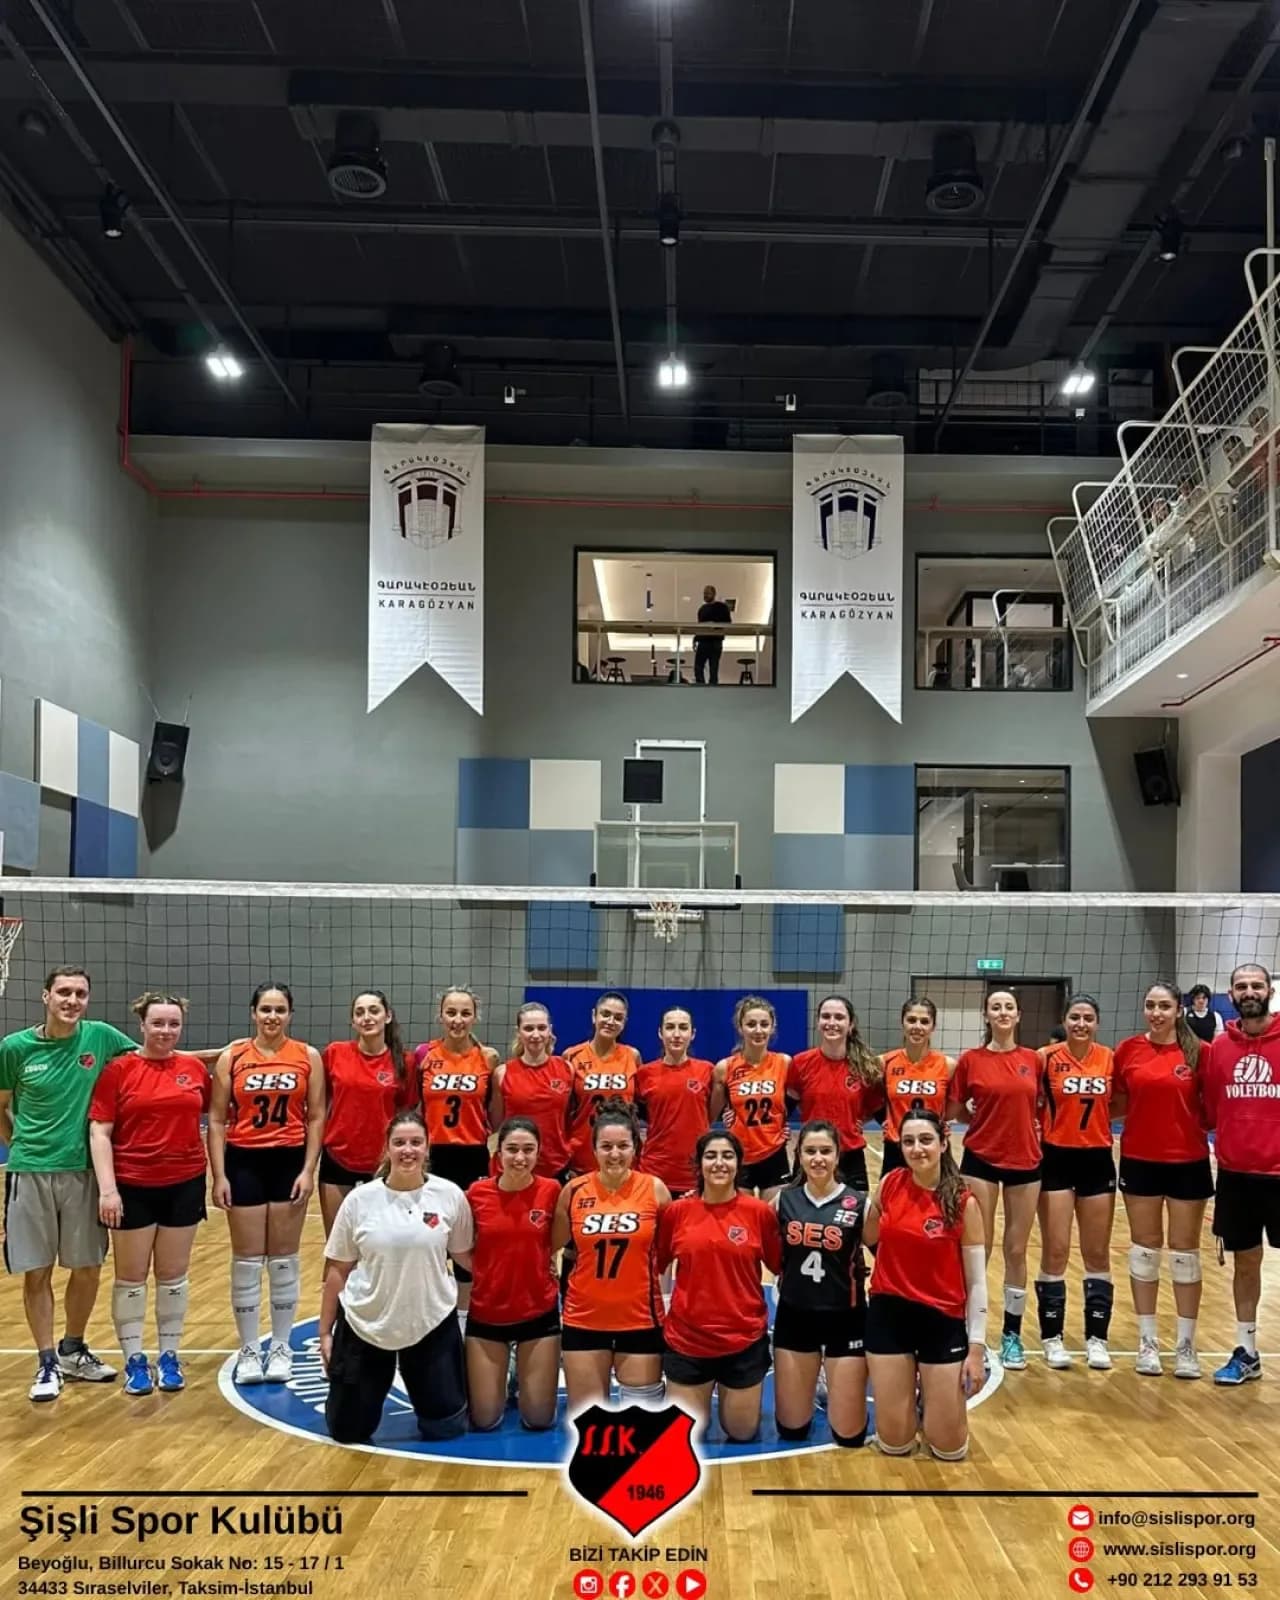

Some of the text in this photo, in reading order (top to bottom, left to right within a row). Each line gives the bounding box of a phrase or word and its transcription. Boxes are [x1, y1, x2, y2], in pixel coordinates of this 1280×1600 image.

[378, 598, 475, 610] KARAGÖZYAN
[801, 608, 893, 620] KARAGÖZYAN
[243, 1073, 297, 1092] SES
[430, 1073, 477, 1092] SES
[583, 1073, 628, 1091] SES
[737, 1080, 776, 1096] SES
[895, 1080, 937, 1096] SES
[1063, 1076, 1107, 1095] SES
[252, 1094, 289, 1128] 34
[443, 1095, 462, 1128] 3
[745, 1097, 773, 1127] 22
[1080, 1098, 1095, 1130] 7
[581, 1212, 640, 1235] SES
[786, 1220, 843, 1251] SES
[593, 1238, 630, 1279] 17
[800, 1250, 826, 1283] 4
